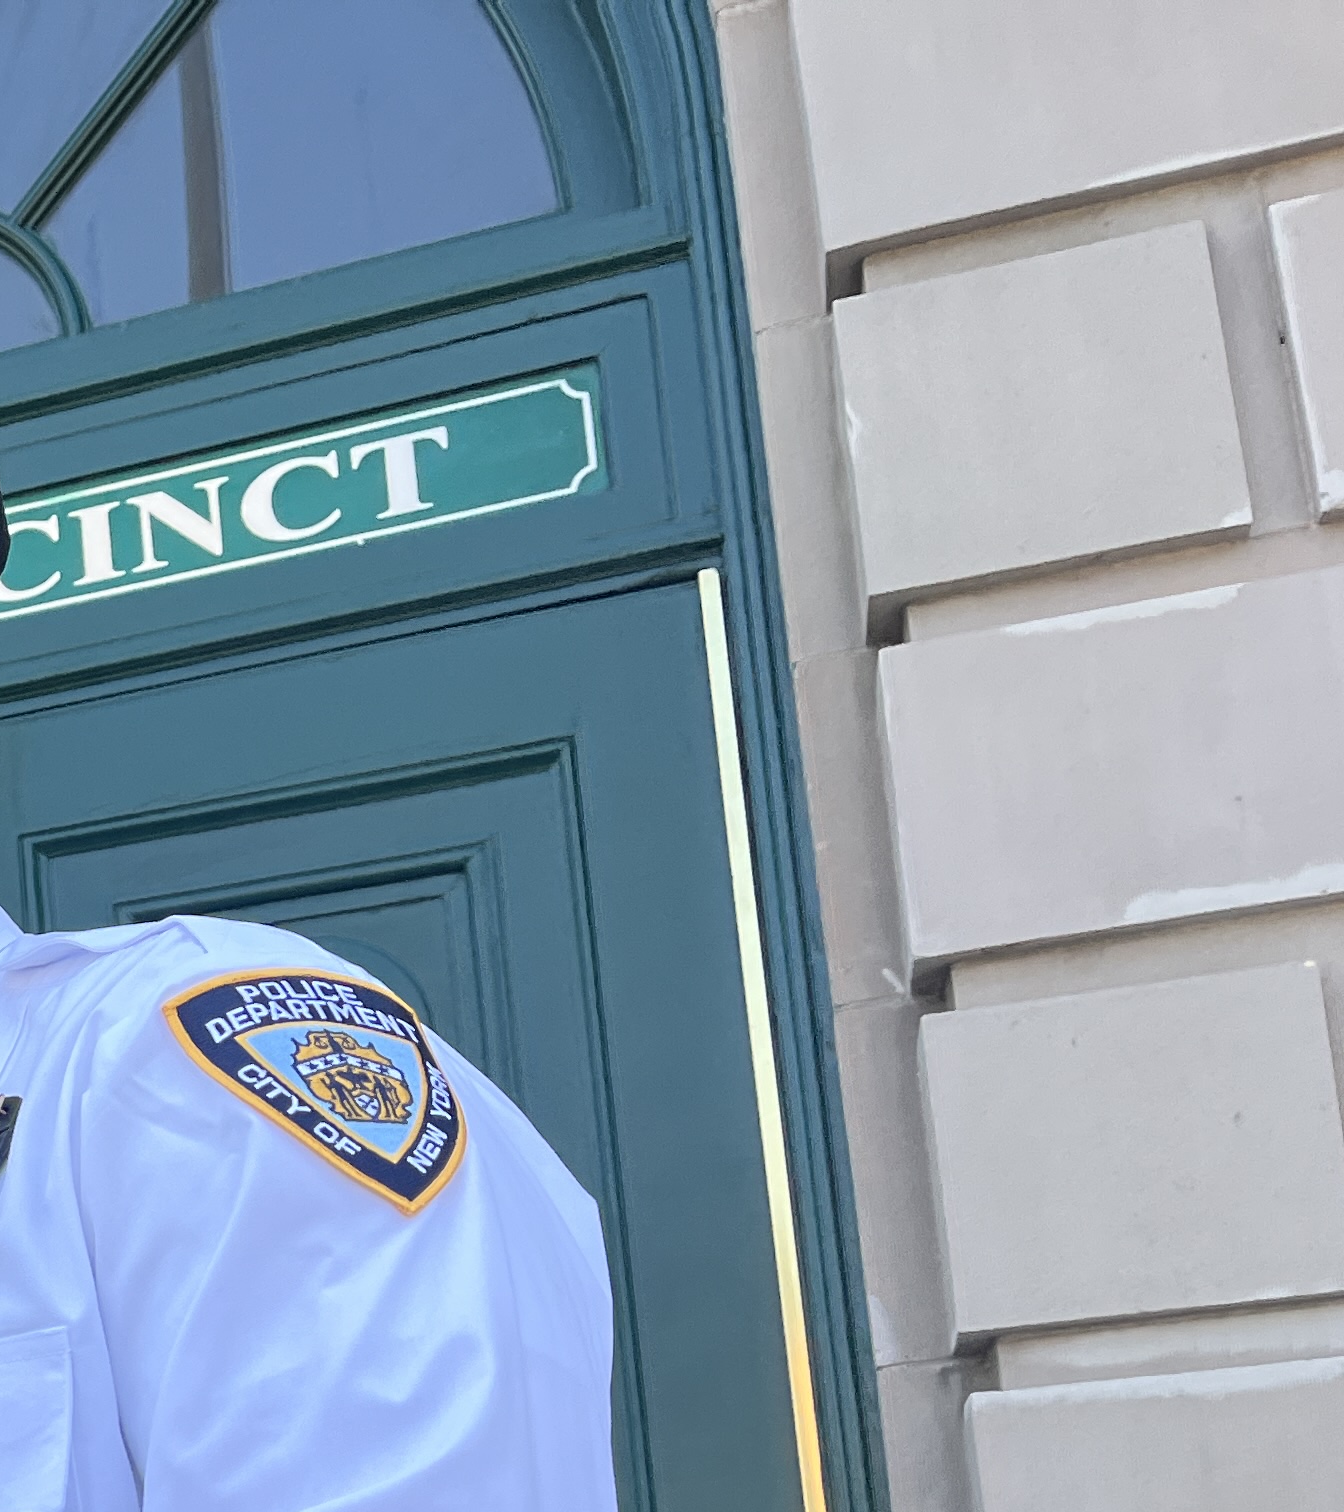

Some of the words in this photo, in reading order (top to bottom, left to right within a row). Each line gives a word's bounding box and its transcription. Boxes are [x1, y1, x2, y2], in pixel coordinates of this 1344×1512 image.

[235, 979, 362, 1006] POLICE
[205, 998, 419, 1044] DEPARTMENT
[237, 1062, 311, 1116] CITY
[425, 1060, 452, 1120] YORK
[313, 1121, 362, 1156] OF
[407, 1123, 448, 1174] NEW
